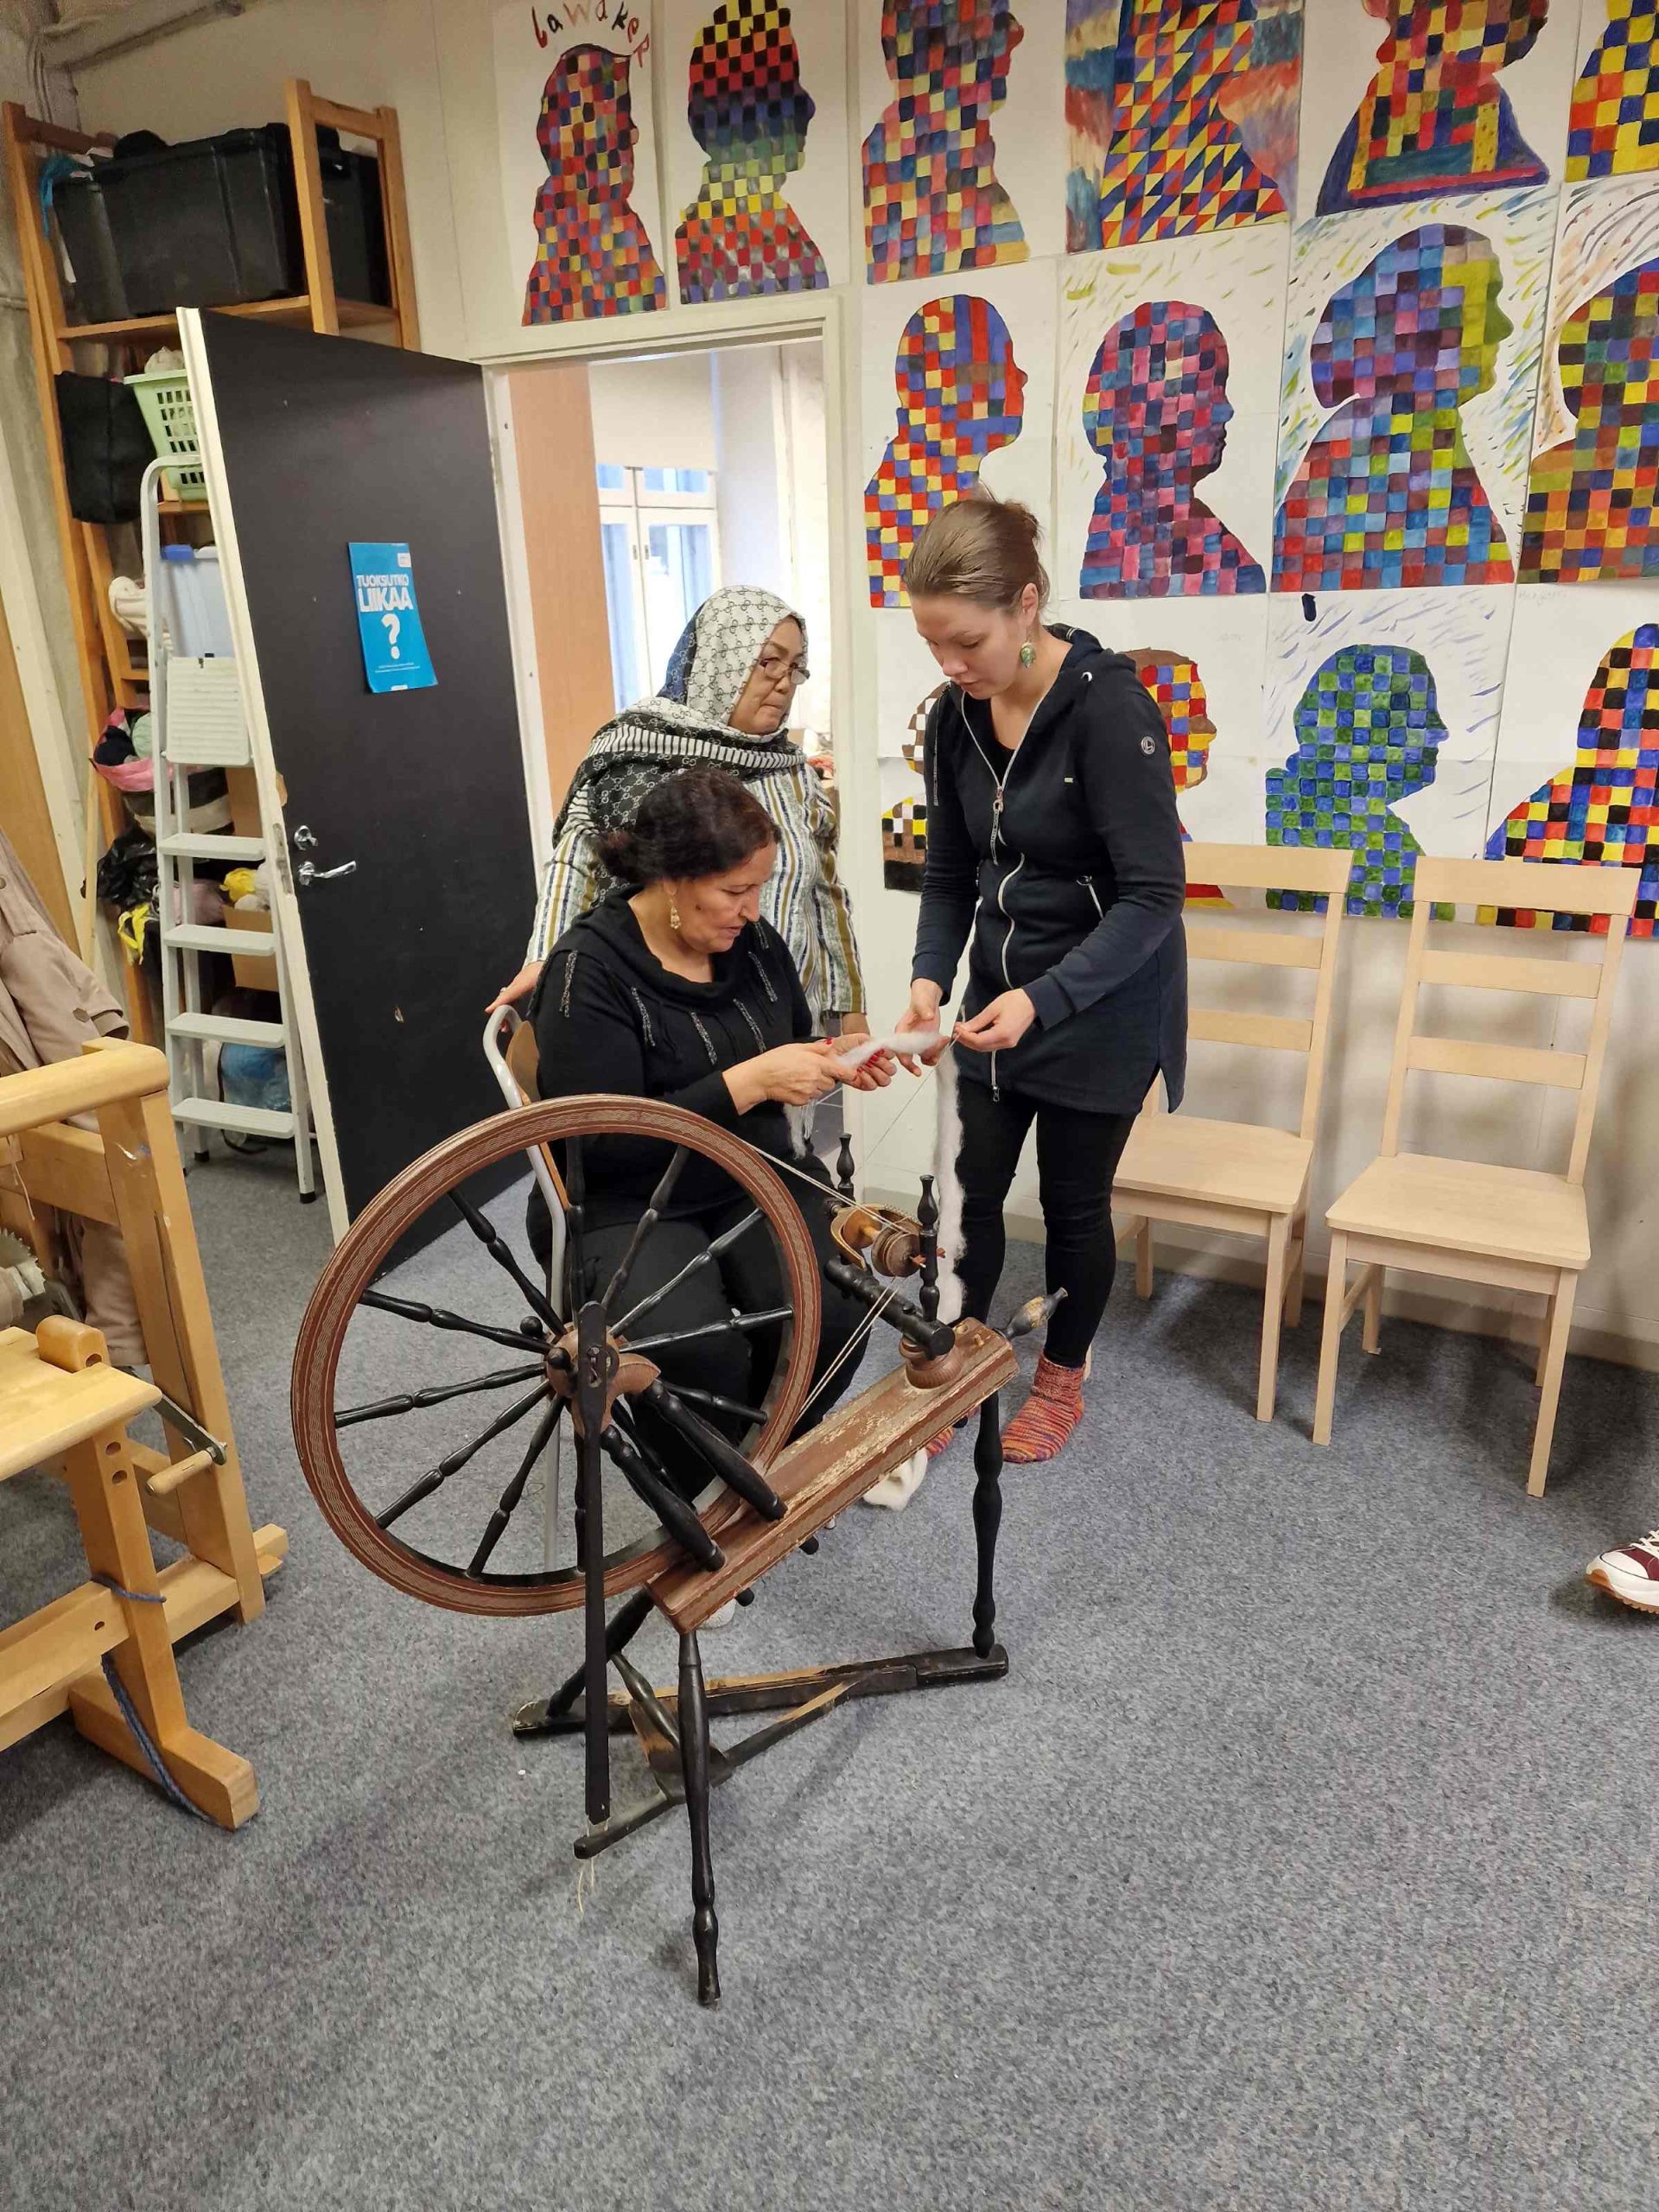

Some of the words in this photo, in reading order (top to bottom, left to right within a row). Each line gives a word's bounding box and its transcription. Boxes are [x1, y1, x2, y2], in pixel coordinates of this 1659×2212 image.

[356, 574, 410, 588] TUOKSUTKO
[358, 587, 414, 613] LIIKAA
[381, 613, 401, 659] ?
